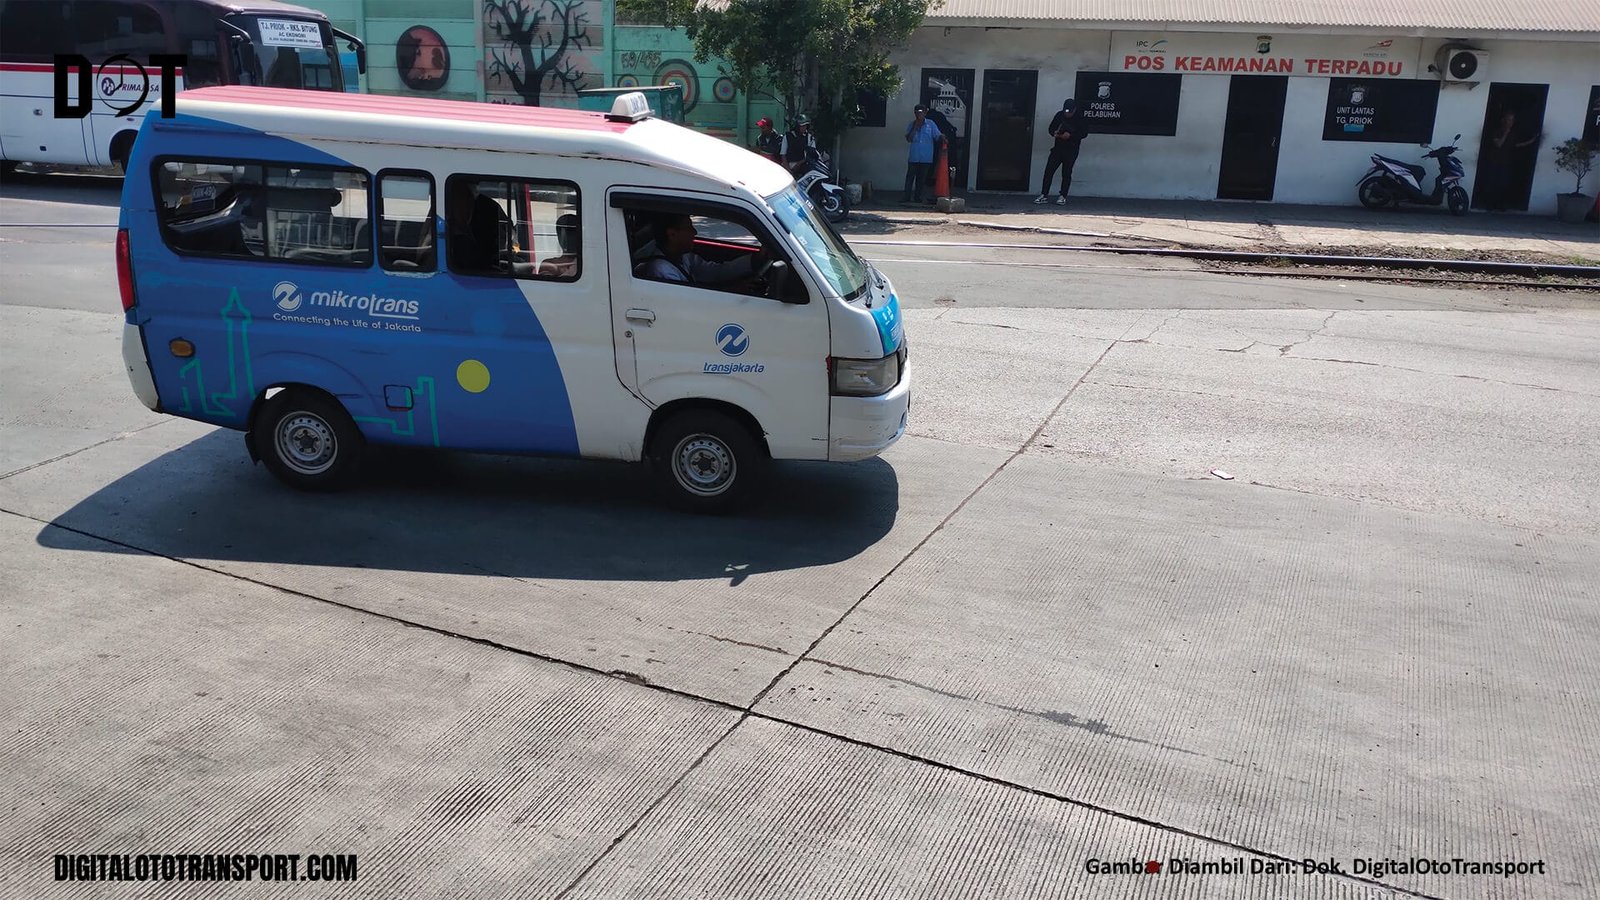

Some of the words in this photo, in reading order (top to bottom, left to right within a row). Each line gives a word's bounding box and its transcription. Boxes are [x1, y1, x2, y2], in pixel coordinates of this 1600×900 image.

[269, 23, 286, 31] PRIOK
[301, 25, 319, 34] BITUNG
[1136, 39, 1149, 48] IPC
[1124, 55, 1165, 71] POS
[1174, 56, 1294, 73] KEAMANAN
[1305, 59, 1403, 76] TERPADU
[116, 83, 160, 93] RIMASA
[1090, 102, 1116, 111] POLRES
[1336, 106, 1351, 114] UNIT
[1351, 107, 1375, 115] LANTAS
[1083, 110, 1121, 118] PELABUHAN
[1348, 116, 1373, 125] PRIOK
[310, 290, 420, 319] mikrotrans
[272, 312, 331, 327] Connecting
[333, 318, 349, 327] the
[352, 319, 368, 328] Life
[371, 321, 382, 329] of
[384, 322, 422, 333] Jakarta
[703, 362, 765, 375] transjakarta
